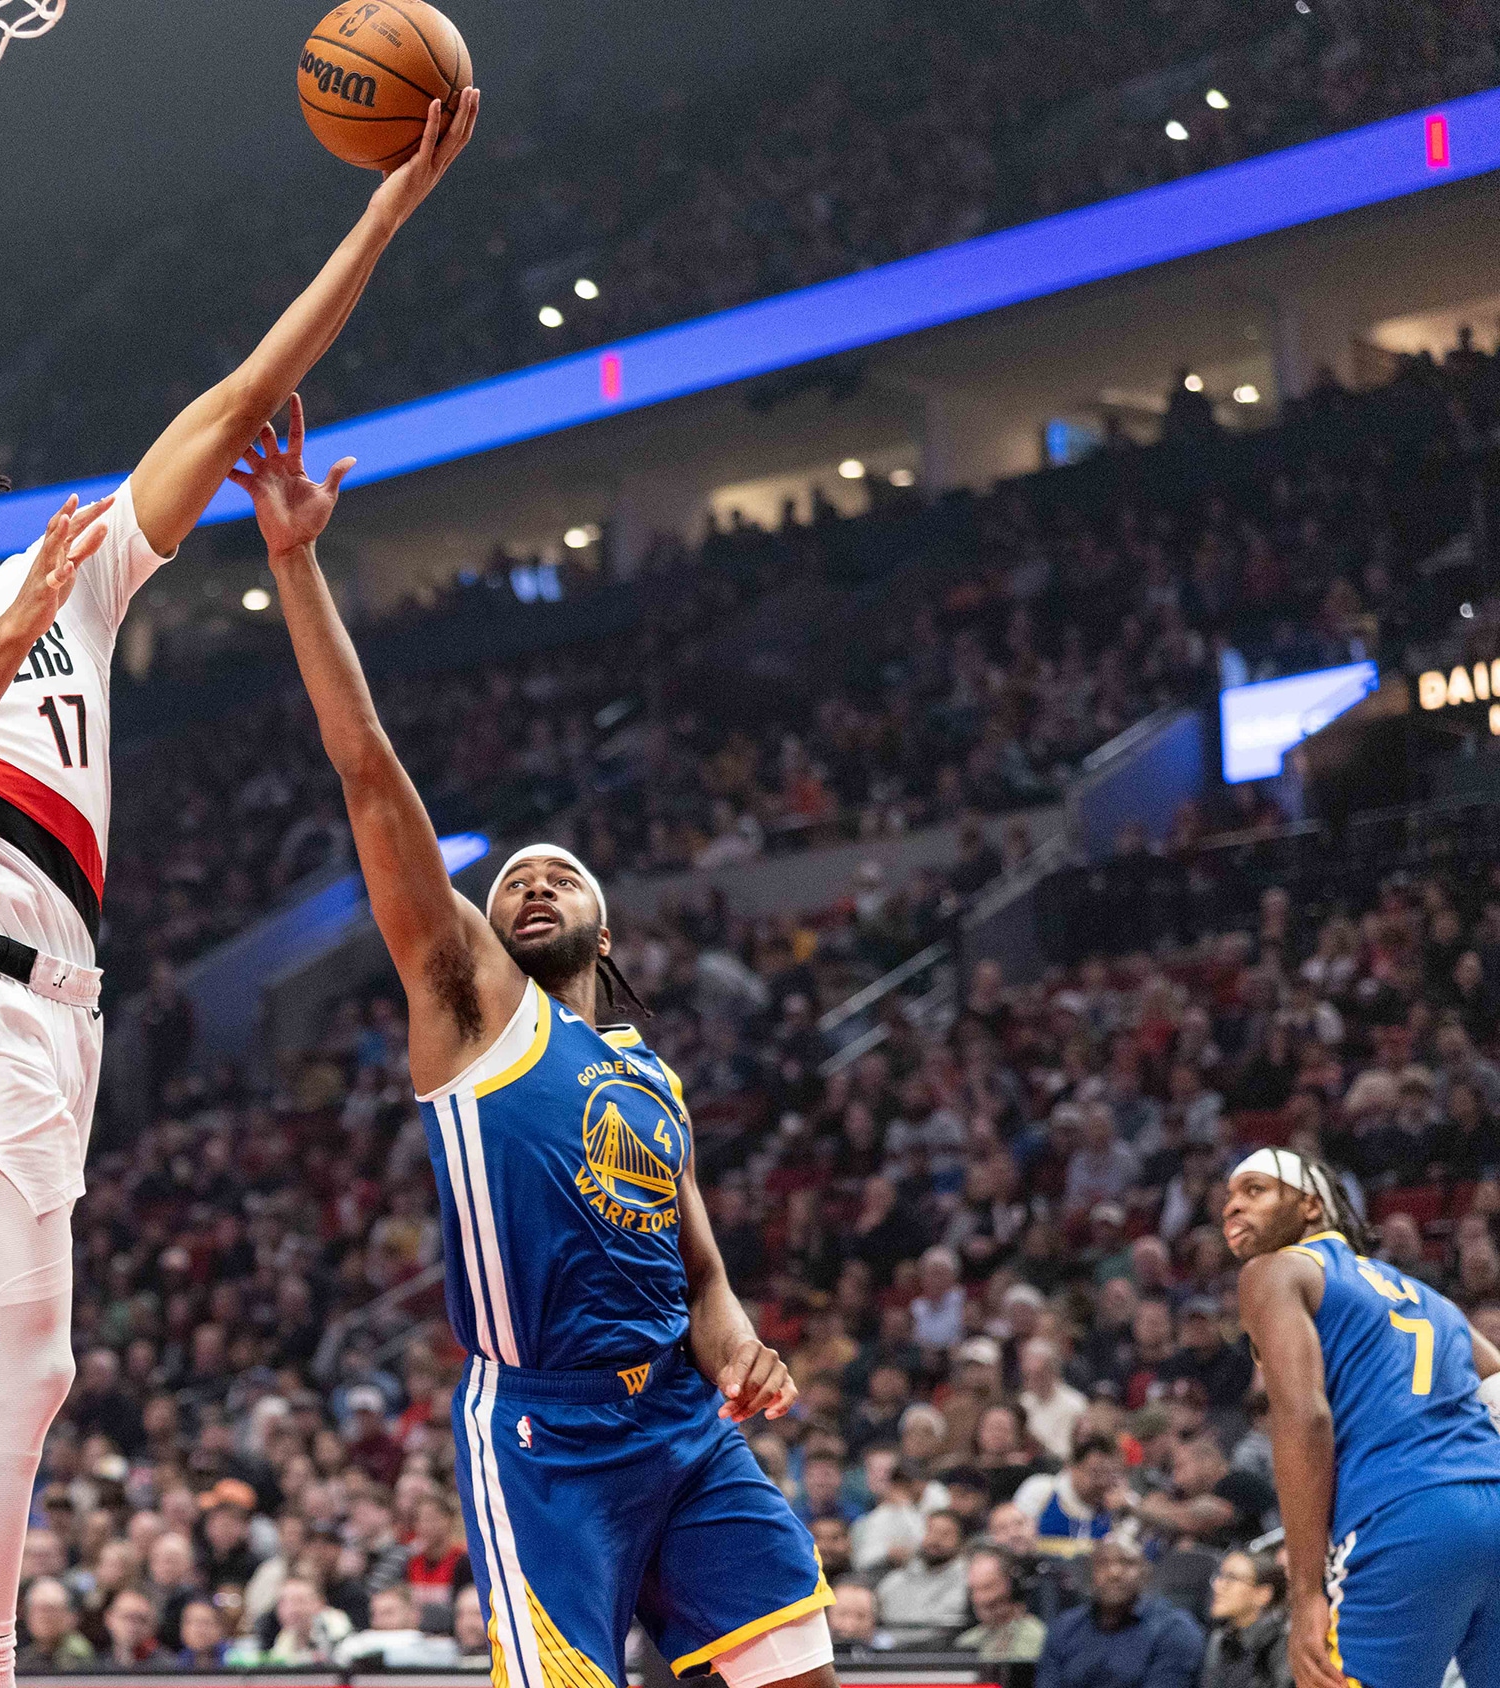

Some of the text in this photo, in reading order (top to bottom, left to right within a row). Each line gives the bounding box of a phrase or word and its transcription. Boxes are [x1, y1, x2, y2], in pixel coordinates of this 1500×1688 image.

[37, 694, 88, 768] 17
[653, 1119, 673, 1154] 4
[1388, 1309, 1434, 1395] 7
